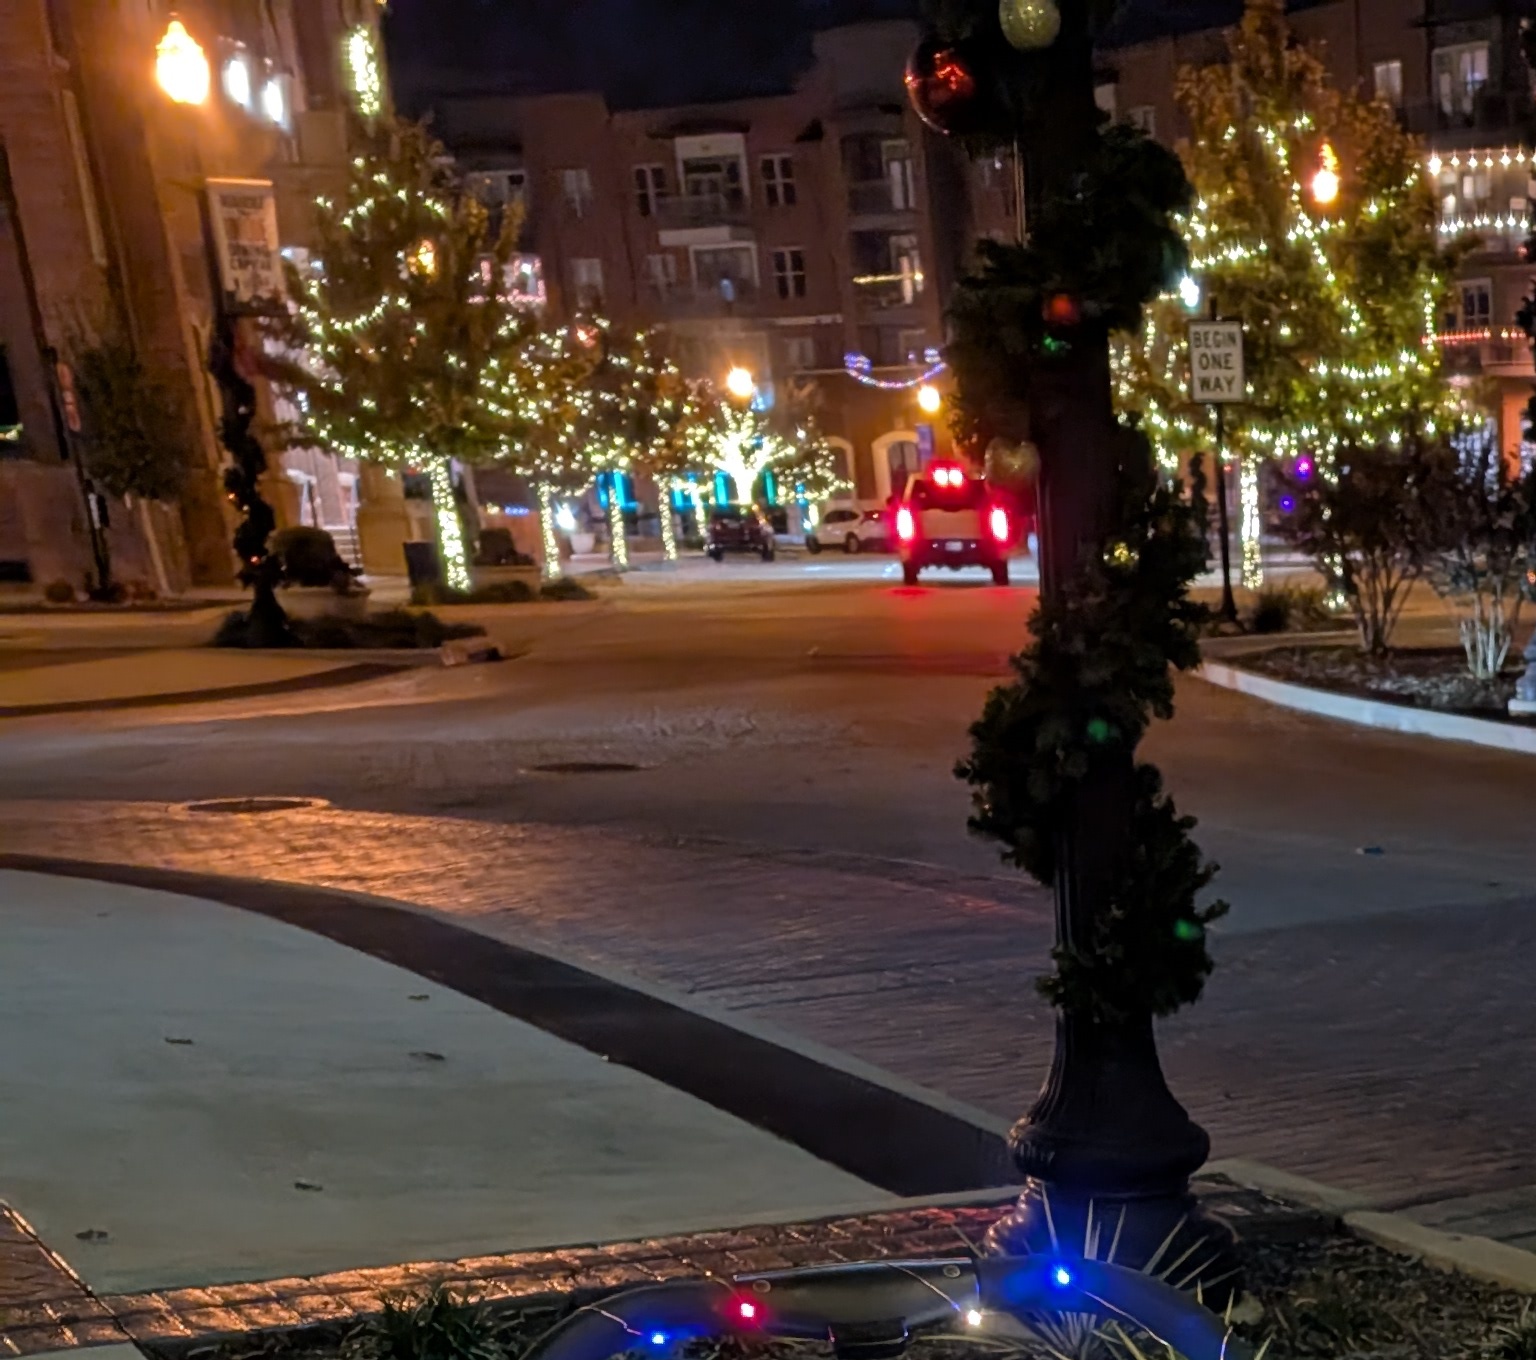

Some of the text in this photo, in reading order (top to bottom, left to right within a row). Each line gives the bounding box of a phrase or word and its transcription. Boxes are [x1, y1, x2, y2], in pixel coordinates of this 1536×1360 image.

[1192, 331, 1237, 348] BEGIN
[1198, 352, 1235, 370] ONE
[1198, 376, 1236, 393] WAY
